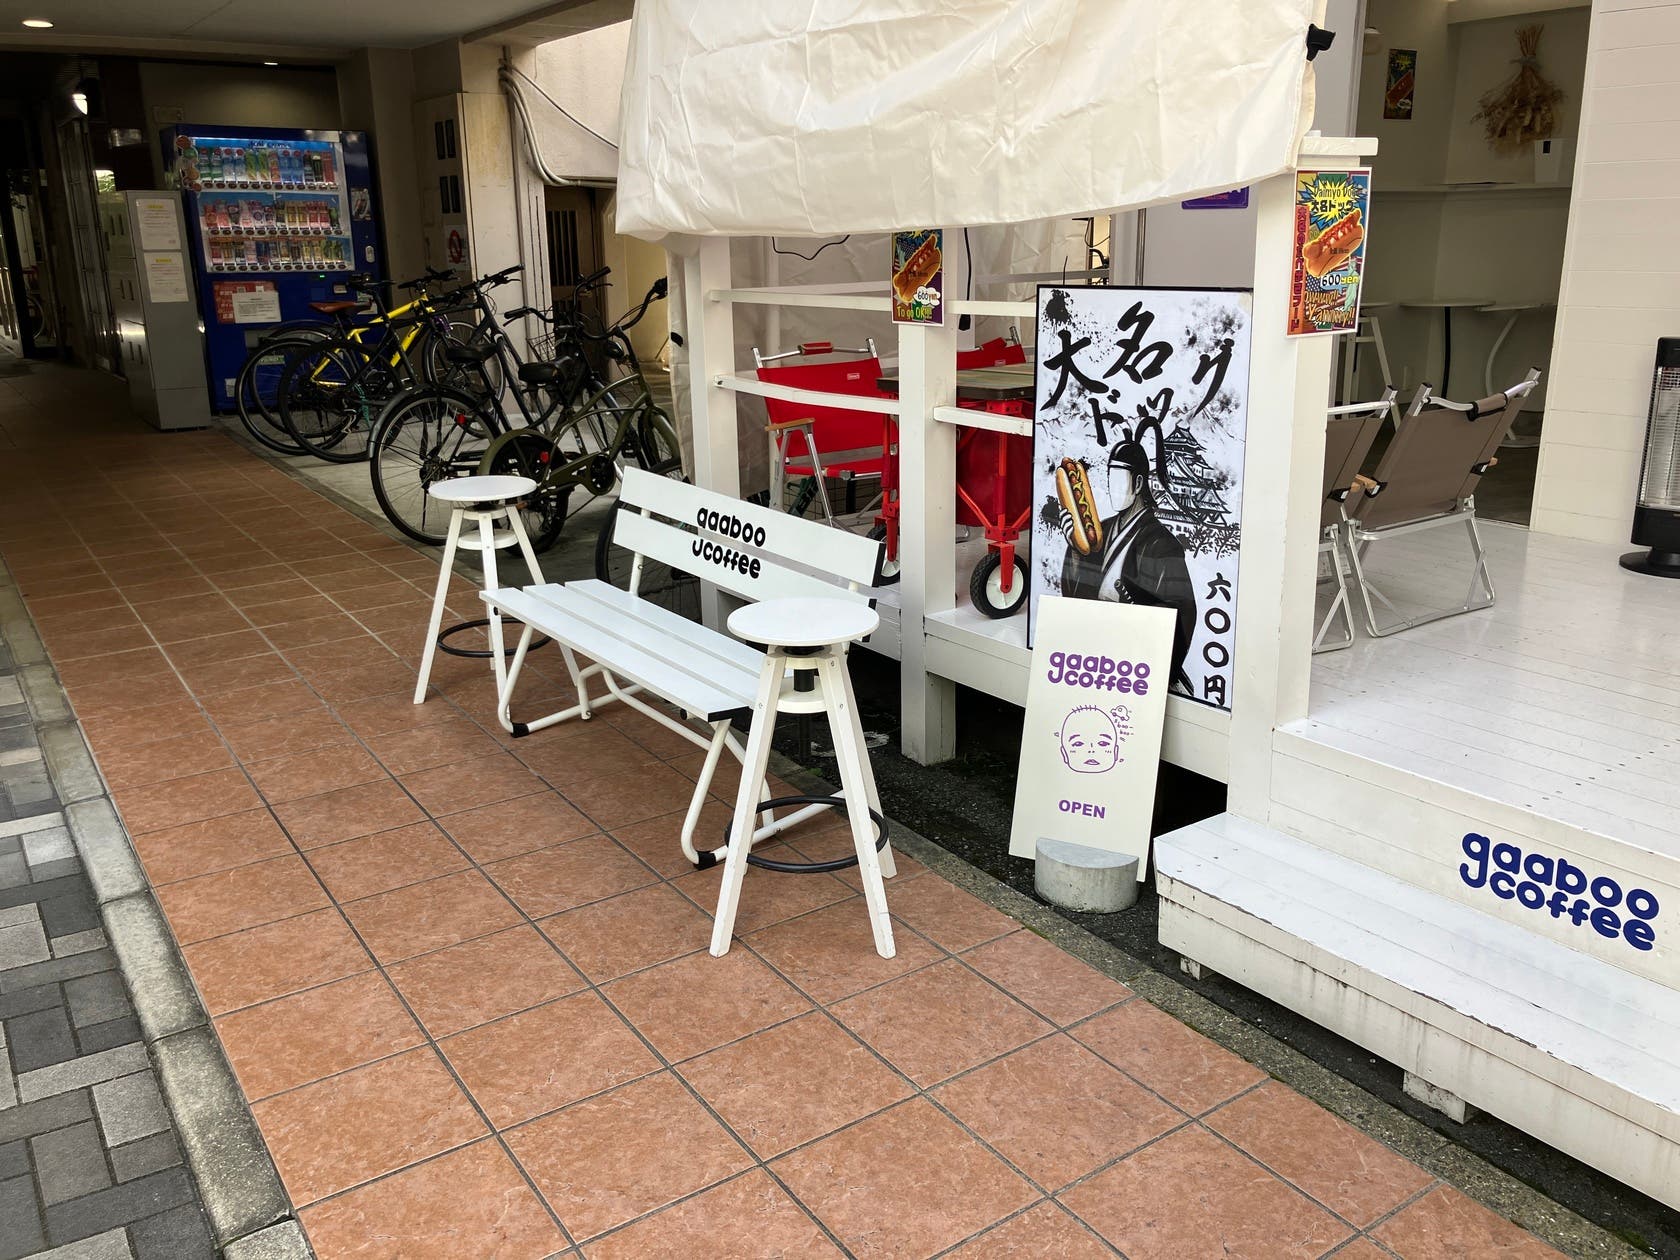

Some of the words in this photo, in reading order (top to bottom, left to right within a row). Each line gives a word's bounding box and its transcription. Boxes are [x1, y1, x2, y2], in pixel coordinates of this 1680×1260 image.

[1048, 652, 1150, 684] gaaboo
[1064, 670, 1149, 695] coffee
[1058, 800, 1106, 819] OPEN
[1460, 833, 1660, 920] gaaboo
[1490, 871, 1656, 951] coffee
